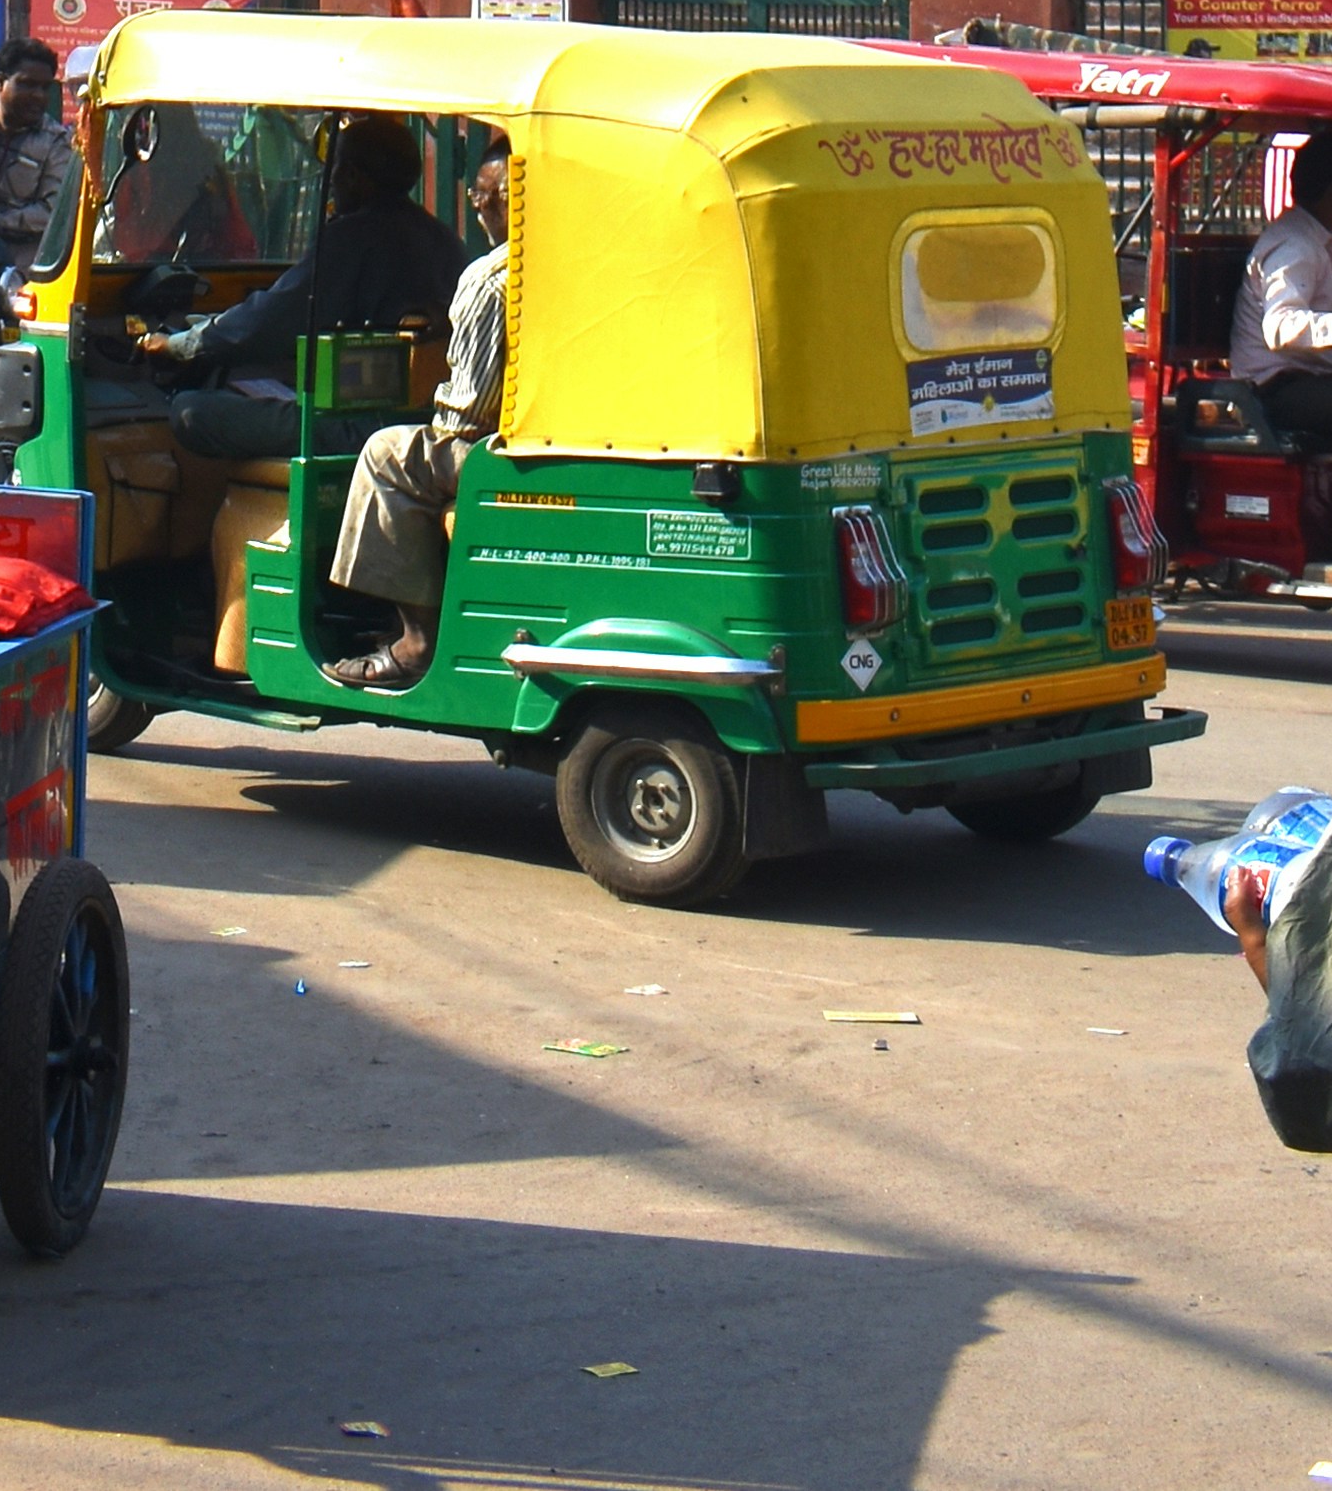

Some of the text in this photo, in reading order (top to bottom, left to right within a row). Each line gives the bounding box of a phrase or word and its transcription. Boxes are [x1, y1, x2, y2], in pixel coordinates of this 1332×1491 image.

[1174, 13, 1198, 24] Your
[1254, 14, 1264, 24] is
[1073, 62, 1171, 97] Yatri
[977, 376, 997, 388] का
[801, 463, 882, 478] Green Life Motor
